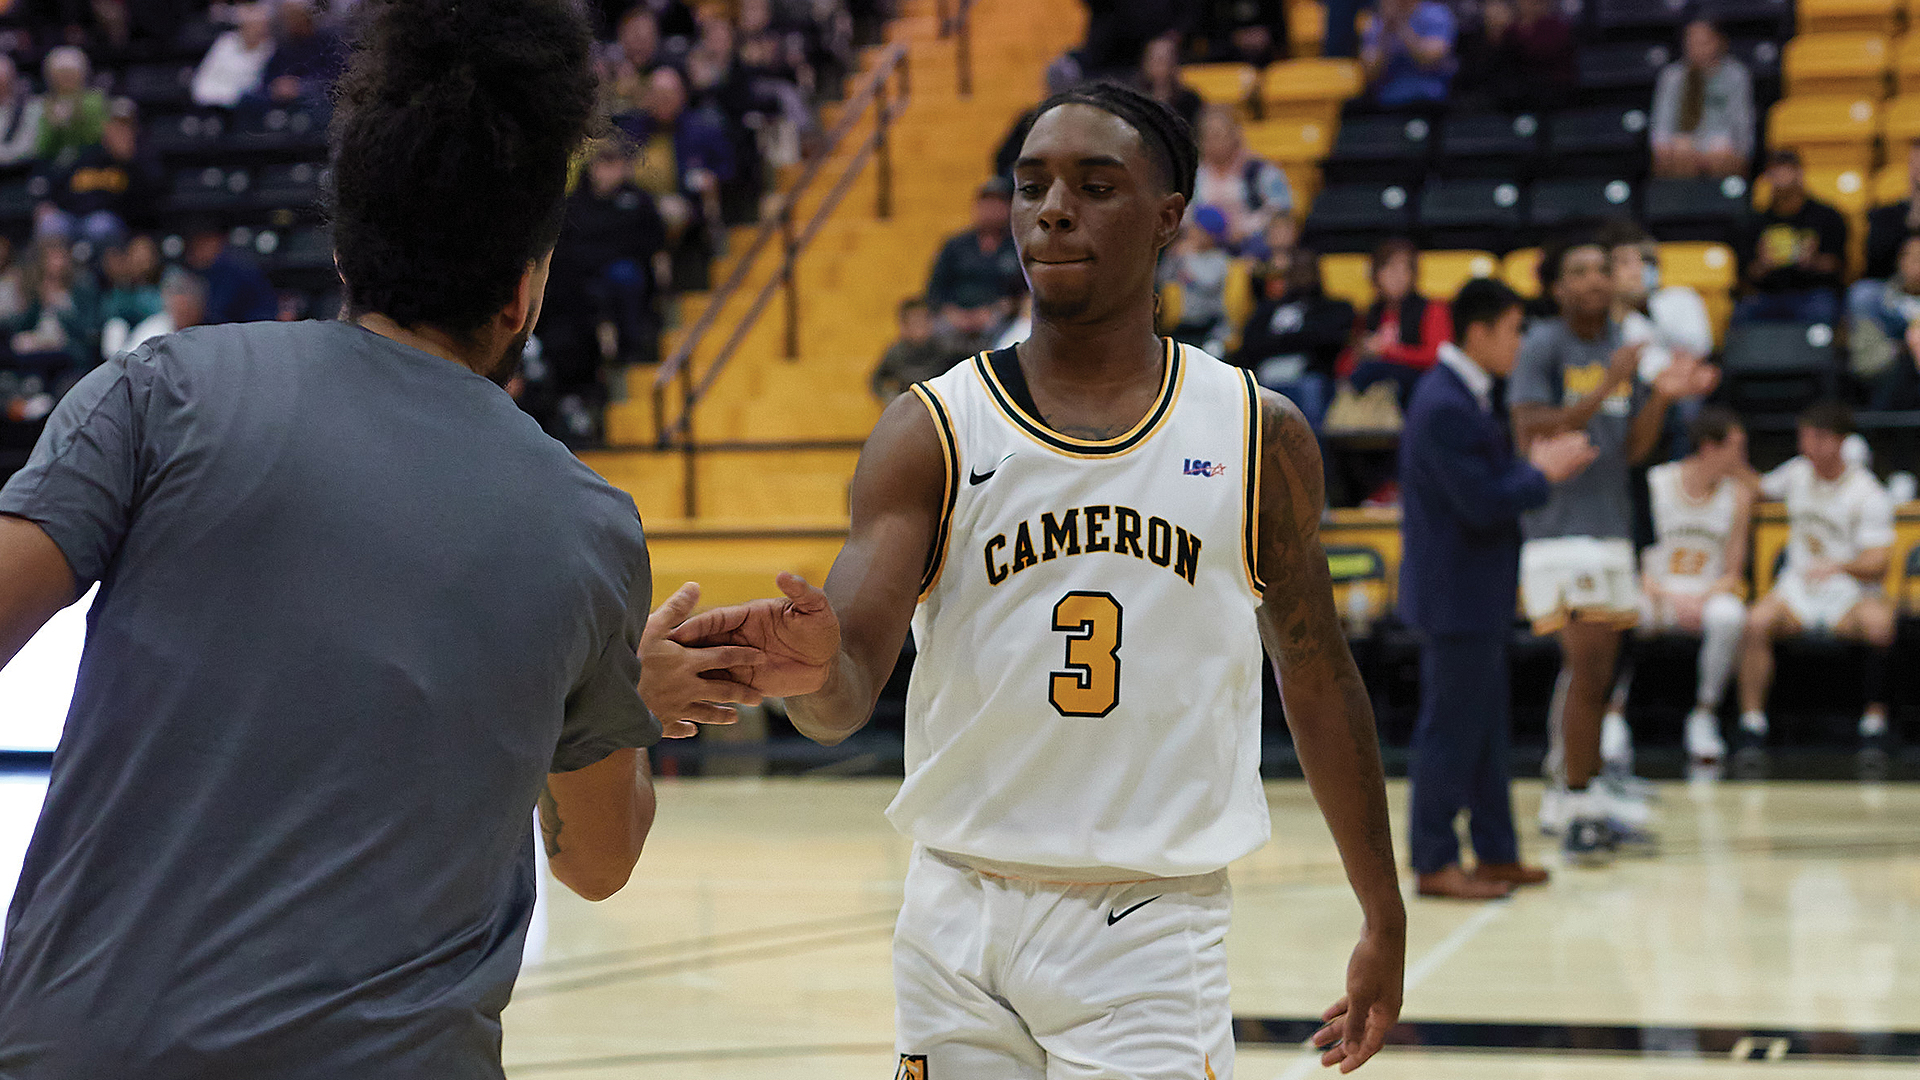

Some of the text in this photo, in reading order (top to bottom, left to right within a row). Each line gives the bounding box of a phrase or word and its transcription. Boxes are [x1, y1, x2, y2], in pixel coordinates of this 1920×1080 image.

[1183, 458, 1212, 478] LSC
[984, 505, 1202, 587] CAMERON
[1048, 590, 1124, 718] 3
